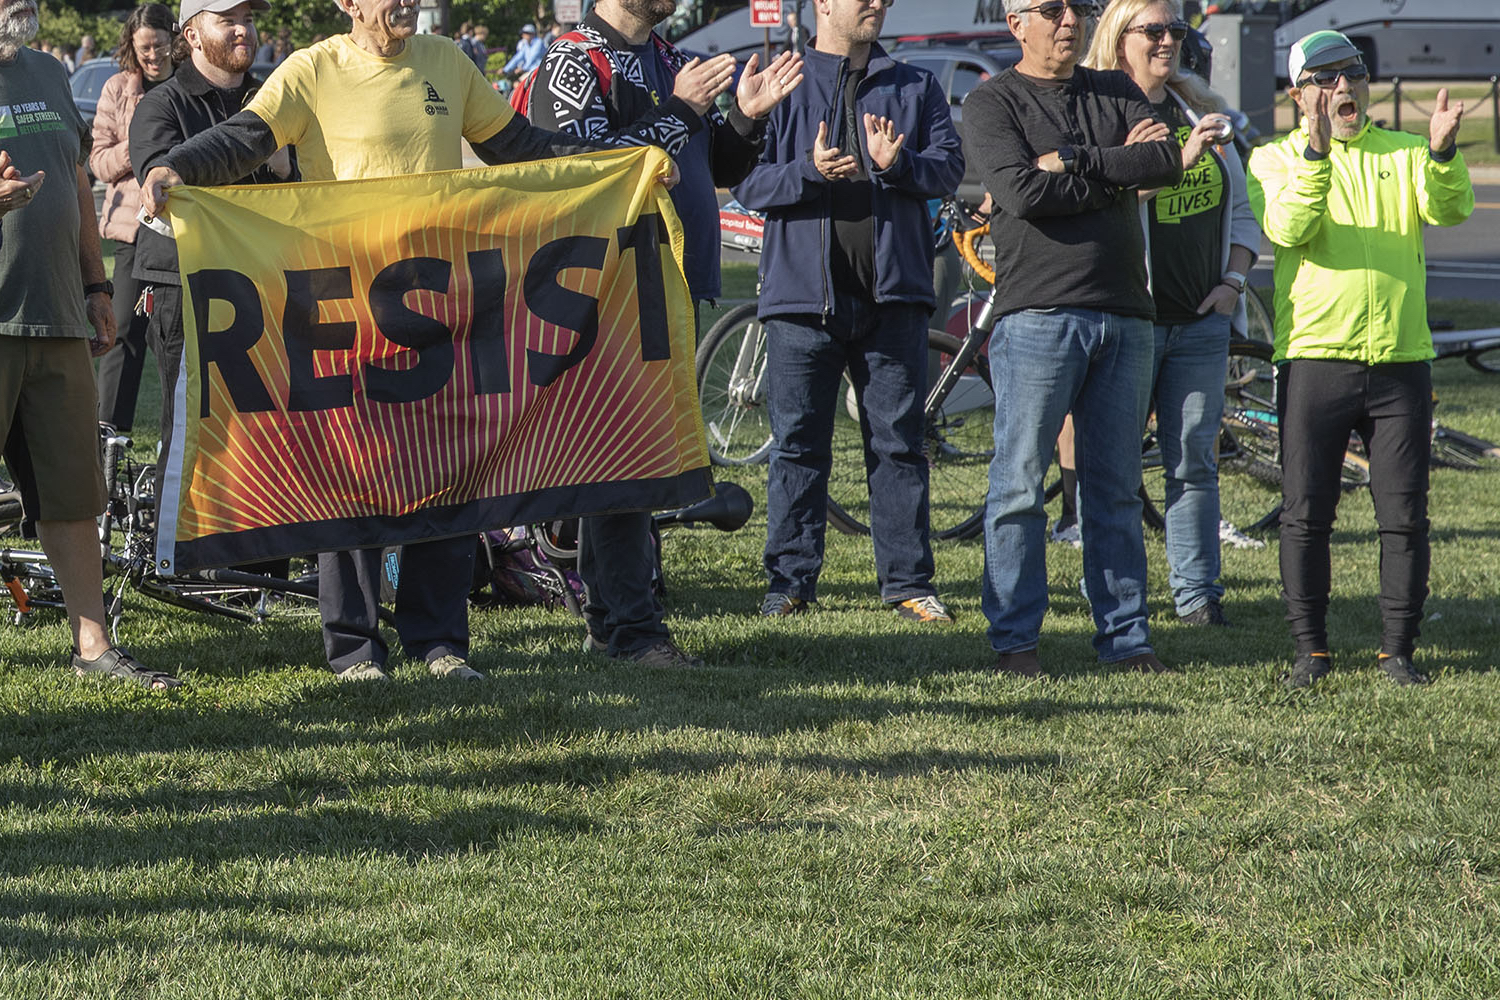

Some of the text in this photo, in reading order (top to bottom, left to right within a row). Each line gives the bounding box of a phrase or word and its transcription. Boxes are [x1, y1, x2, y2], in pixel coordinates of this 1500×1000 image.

[15, 113, 35, 125] SAFER
[21, 102, 39, 113] YEARS
[1172, 167, 1211, 191] AVE
[1169, 190, 1213, 216] LIVES.
[187, 213, 673, 418] RESIST
